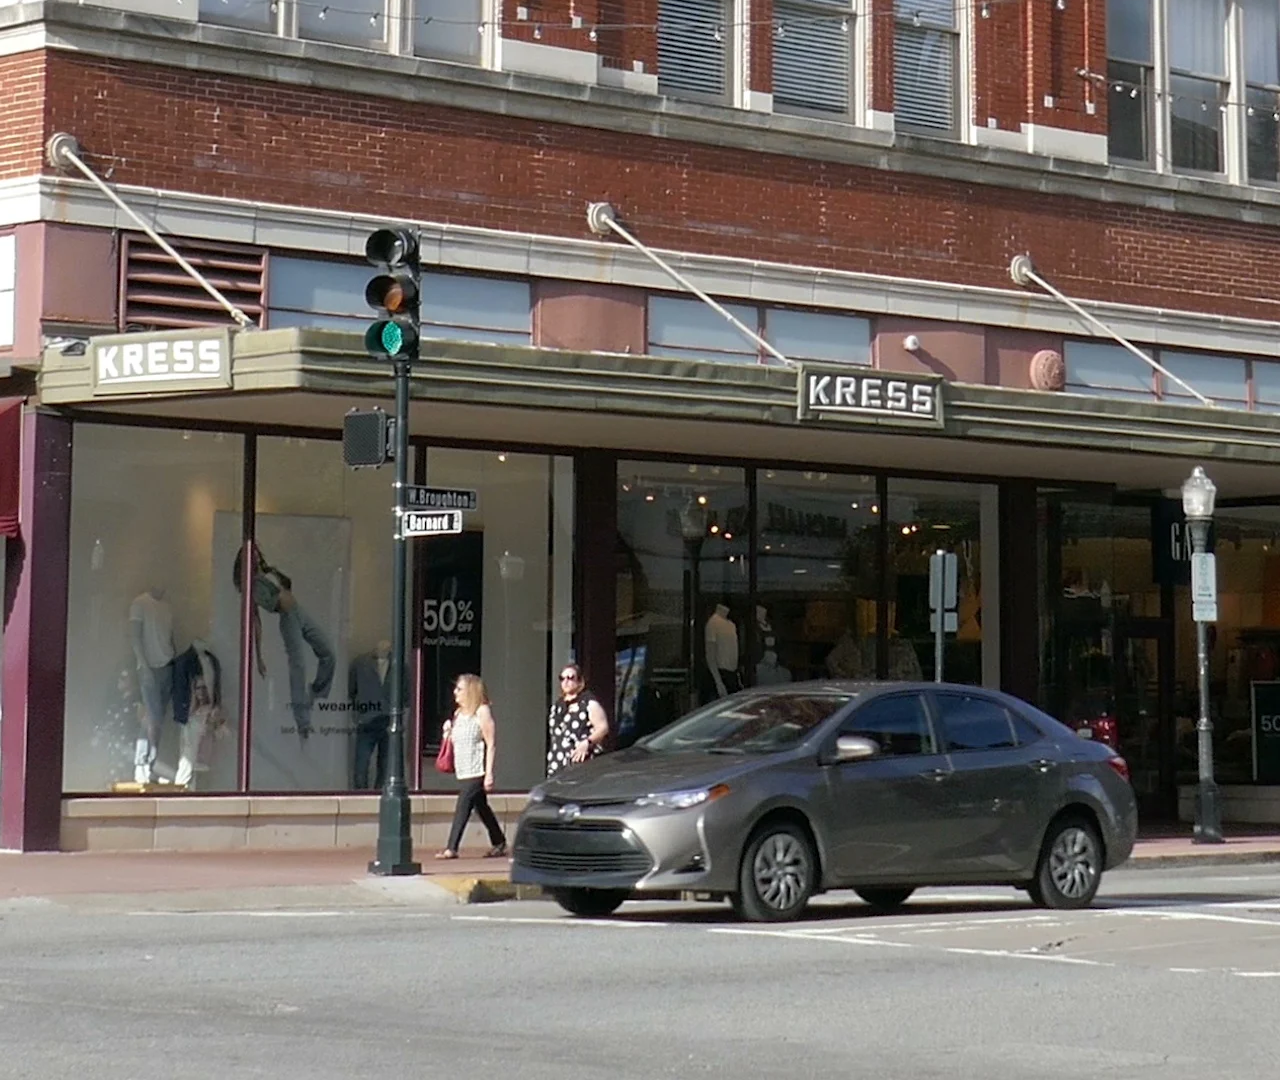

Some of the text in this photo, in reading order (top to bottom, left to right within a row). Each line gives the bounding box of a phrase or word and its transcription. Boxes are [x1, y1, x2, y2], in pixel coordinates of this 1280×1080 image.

[98, 340, 220, 380] KRESS
[809, 375, 933, 413] KRESS
[409, 514, 448, 531] Barnard
[1171, 522, 1192, 560] GA
[423, 599, 474, 633] 50%
